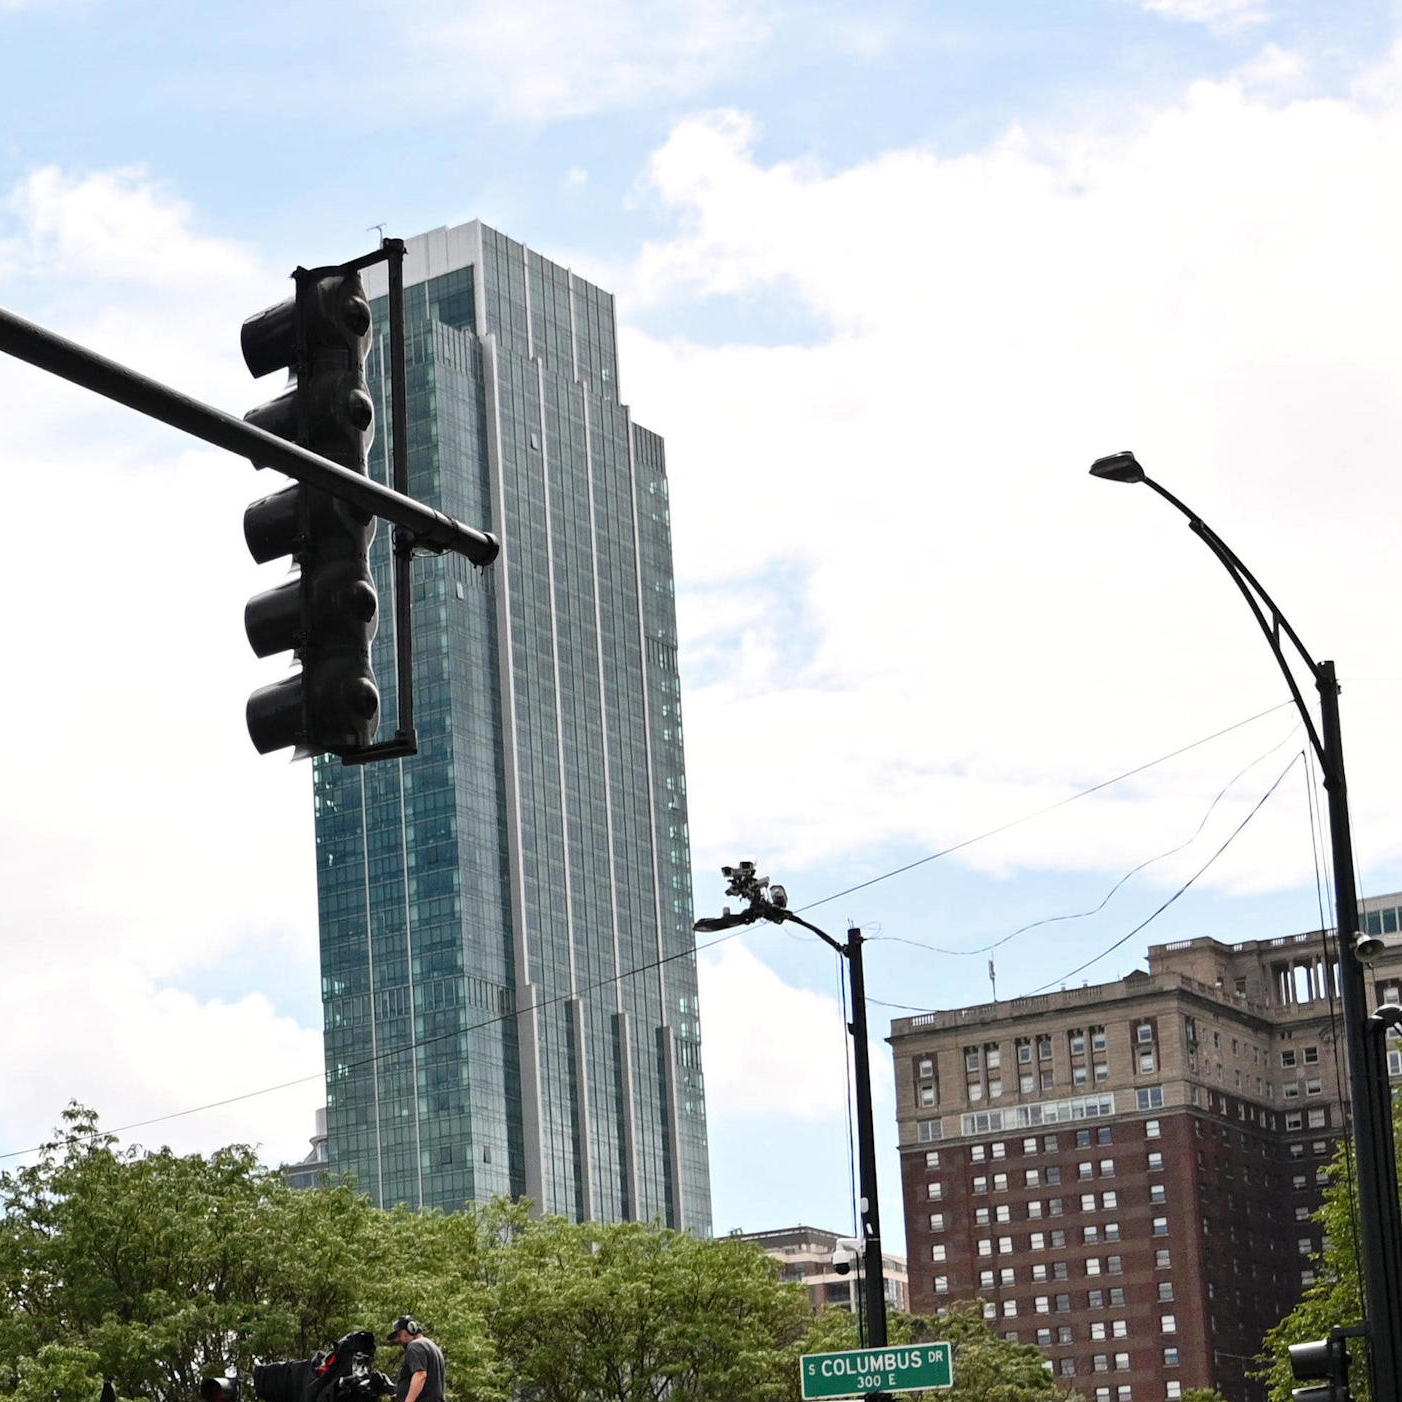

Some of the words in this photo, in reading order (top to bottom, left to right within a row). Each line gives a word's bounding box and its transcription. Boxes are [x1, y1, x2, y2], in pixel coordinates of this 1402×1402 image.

[808, 1364, 816, 1376] S
[821, 1351, 922, 1377] COLUMBUS
[928, 1350, 944, 1363] DR
[857, 1375, 881, 1388] 300
[888, 1373, 896, 1385] E
